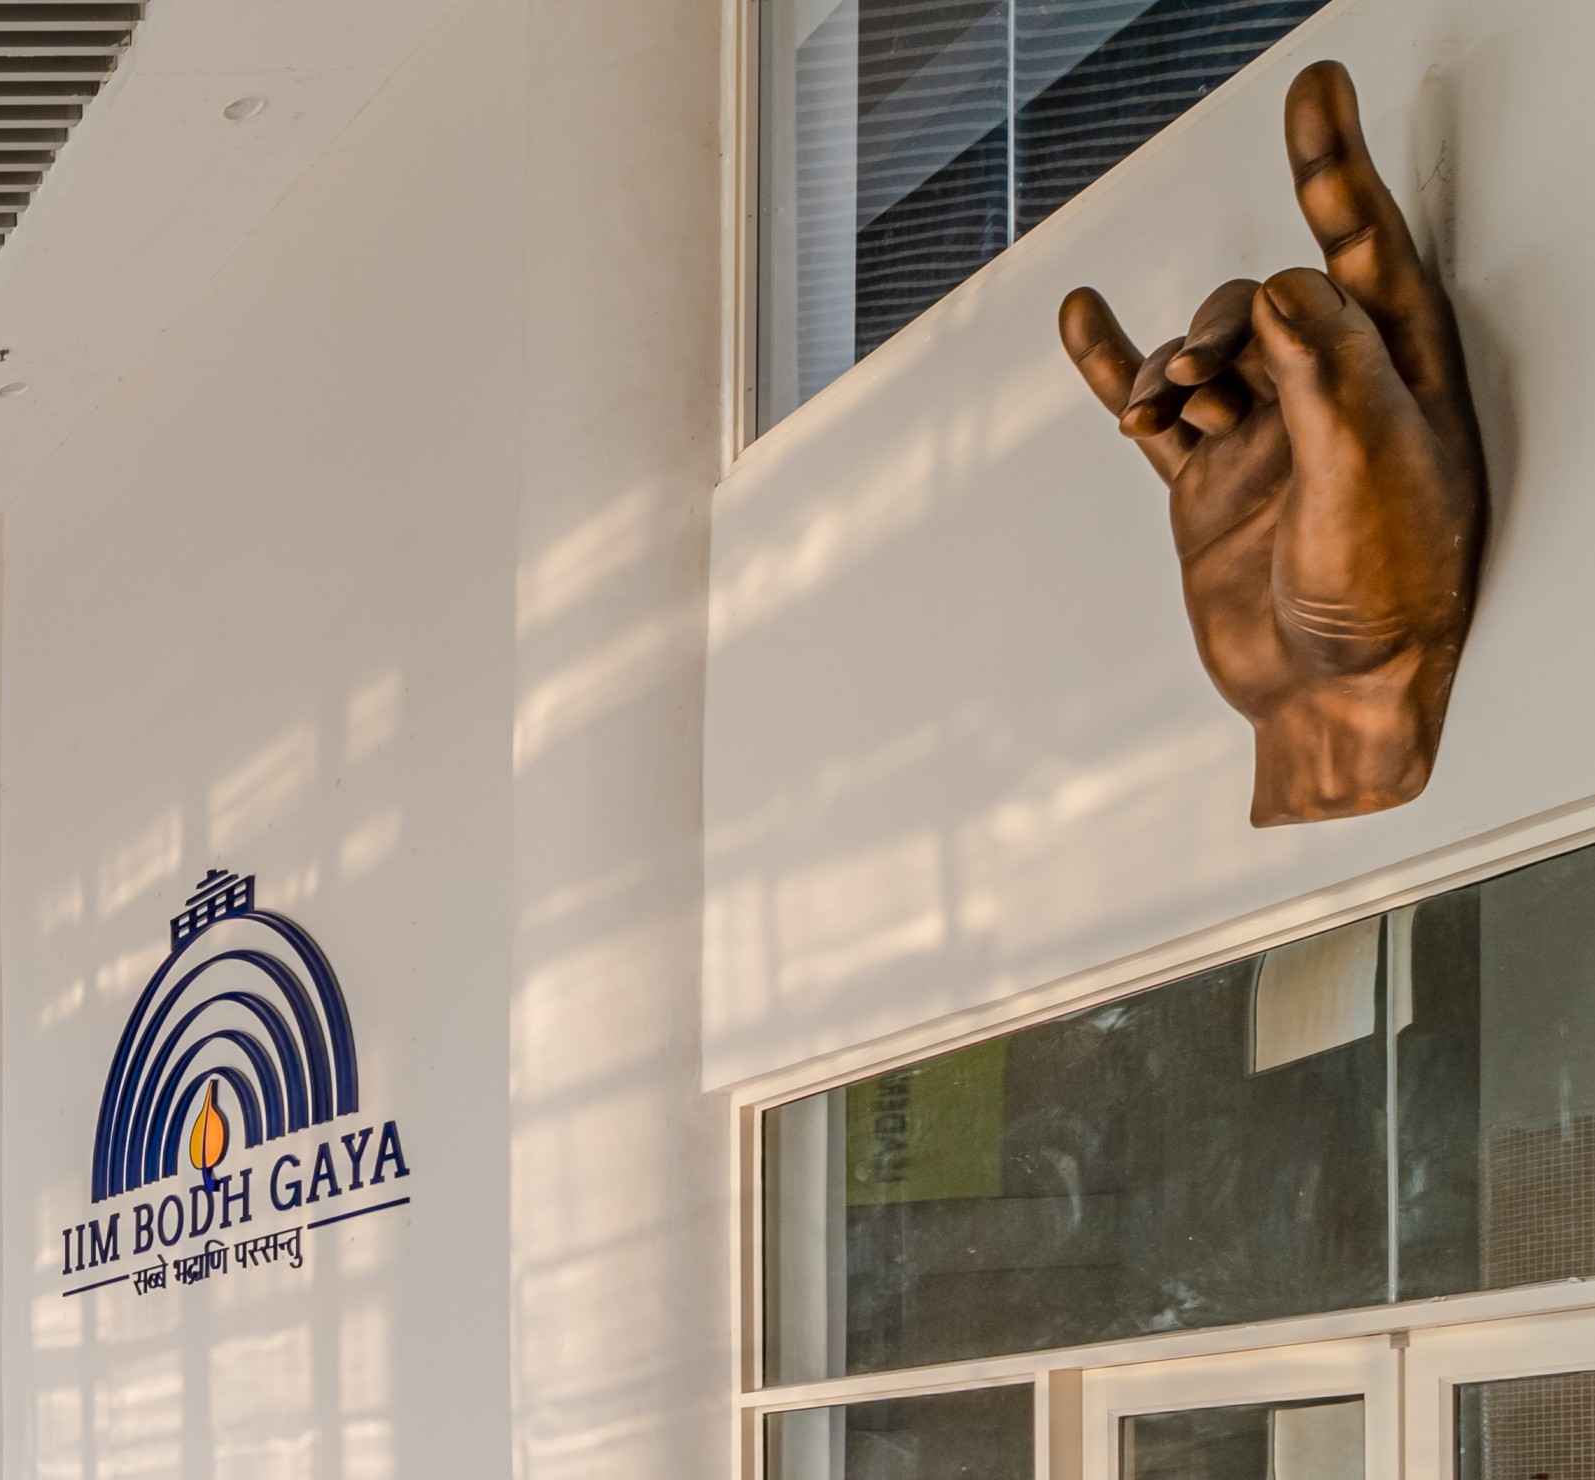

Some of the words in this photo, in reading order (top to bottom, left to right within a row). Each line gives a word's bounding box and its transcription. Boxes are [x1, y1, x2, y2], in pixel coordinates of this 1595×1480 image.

[62, 1213, 121, 1276] IIM
[132, 1167, 253, 1256] BODH
[269, 1119, 411, 1213] GAYA
[233, 1226, 303, 1269] पस्सन्तु
